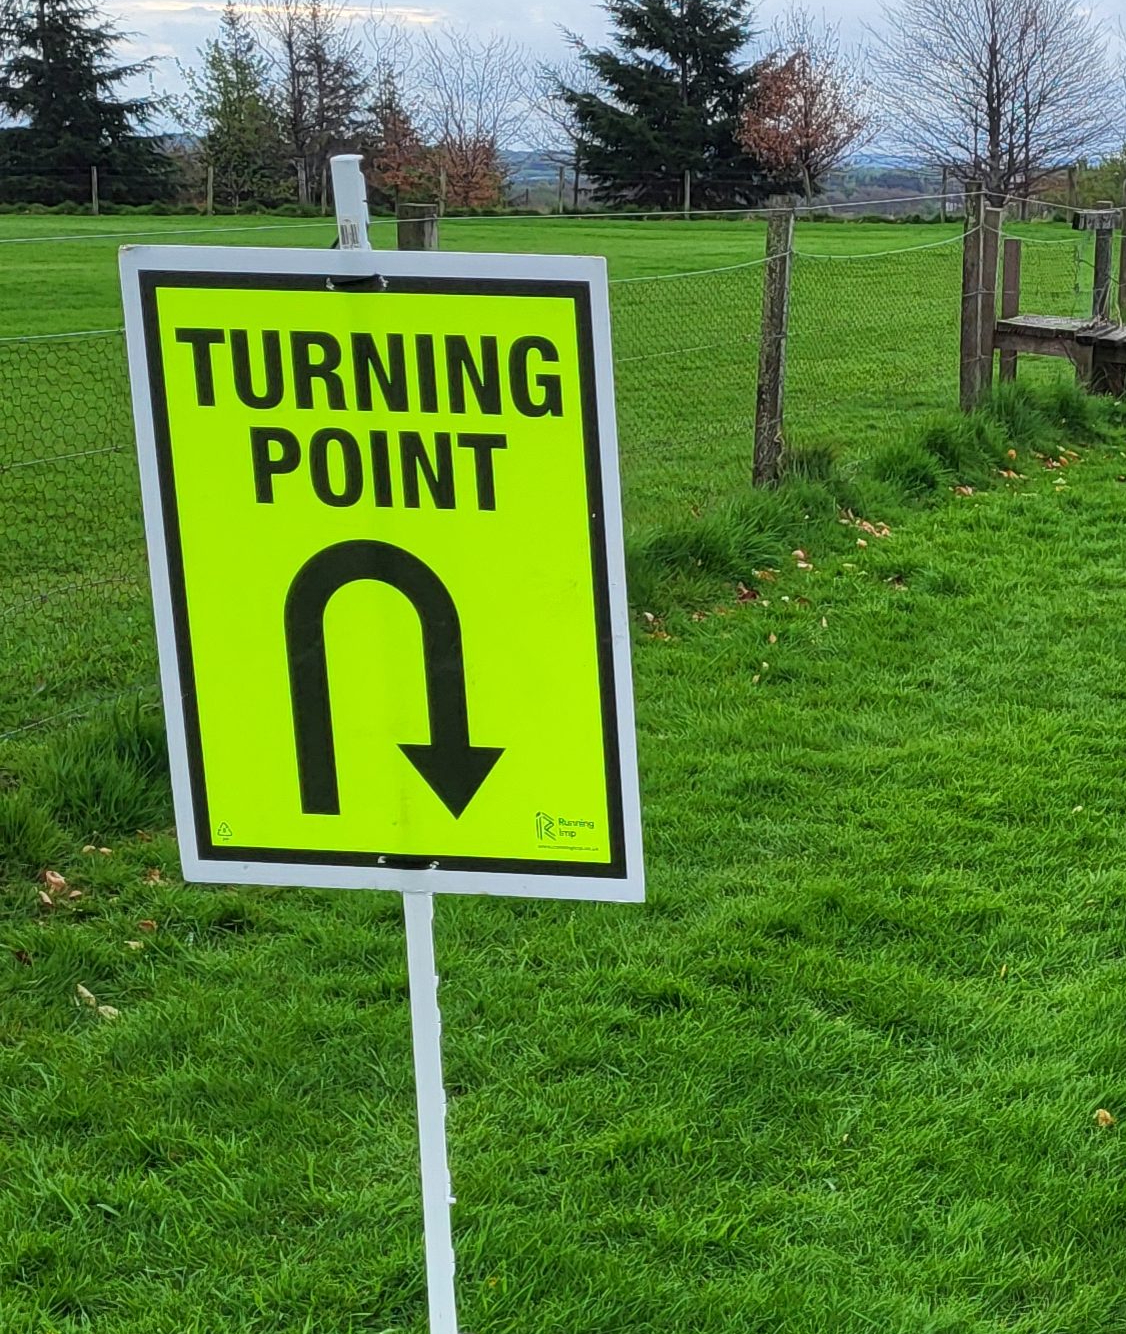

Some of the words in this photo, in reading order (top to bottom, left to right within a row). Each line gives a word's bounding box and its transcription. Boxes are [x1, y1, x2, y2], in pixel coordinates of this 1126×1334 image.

[175, 327, 563, 417] TURNING
[250, 426, 507, 511] POINT
[558, 817, 594, 829] Running
